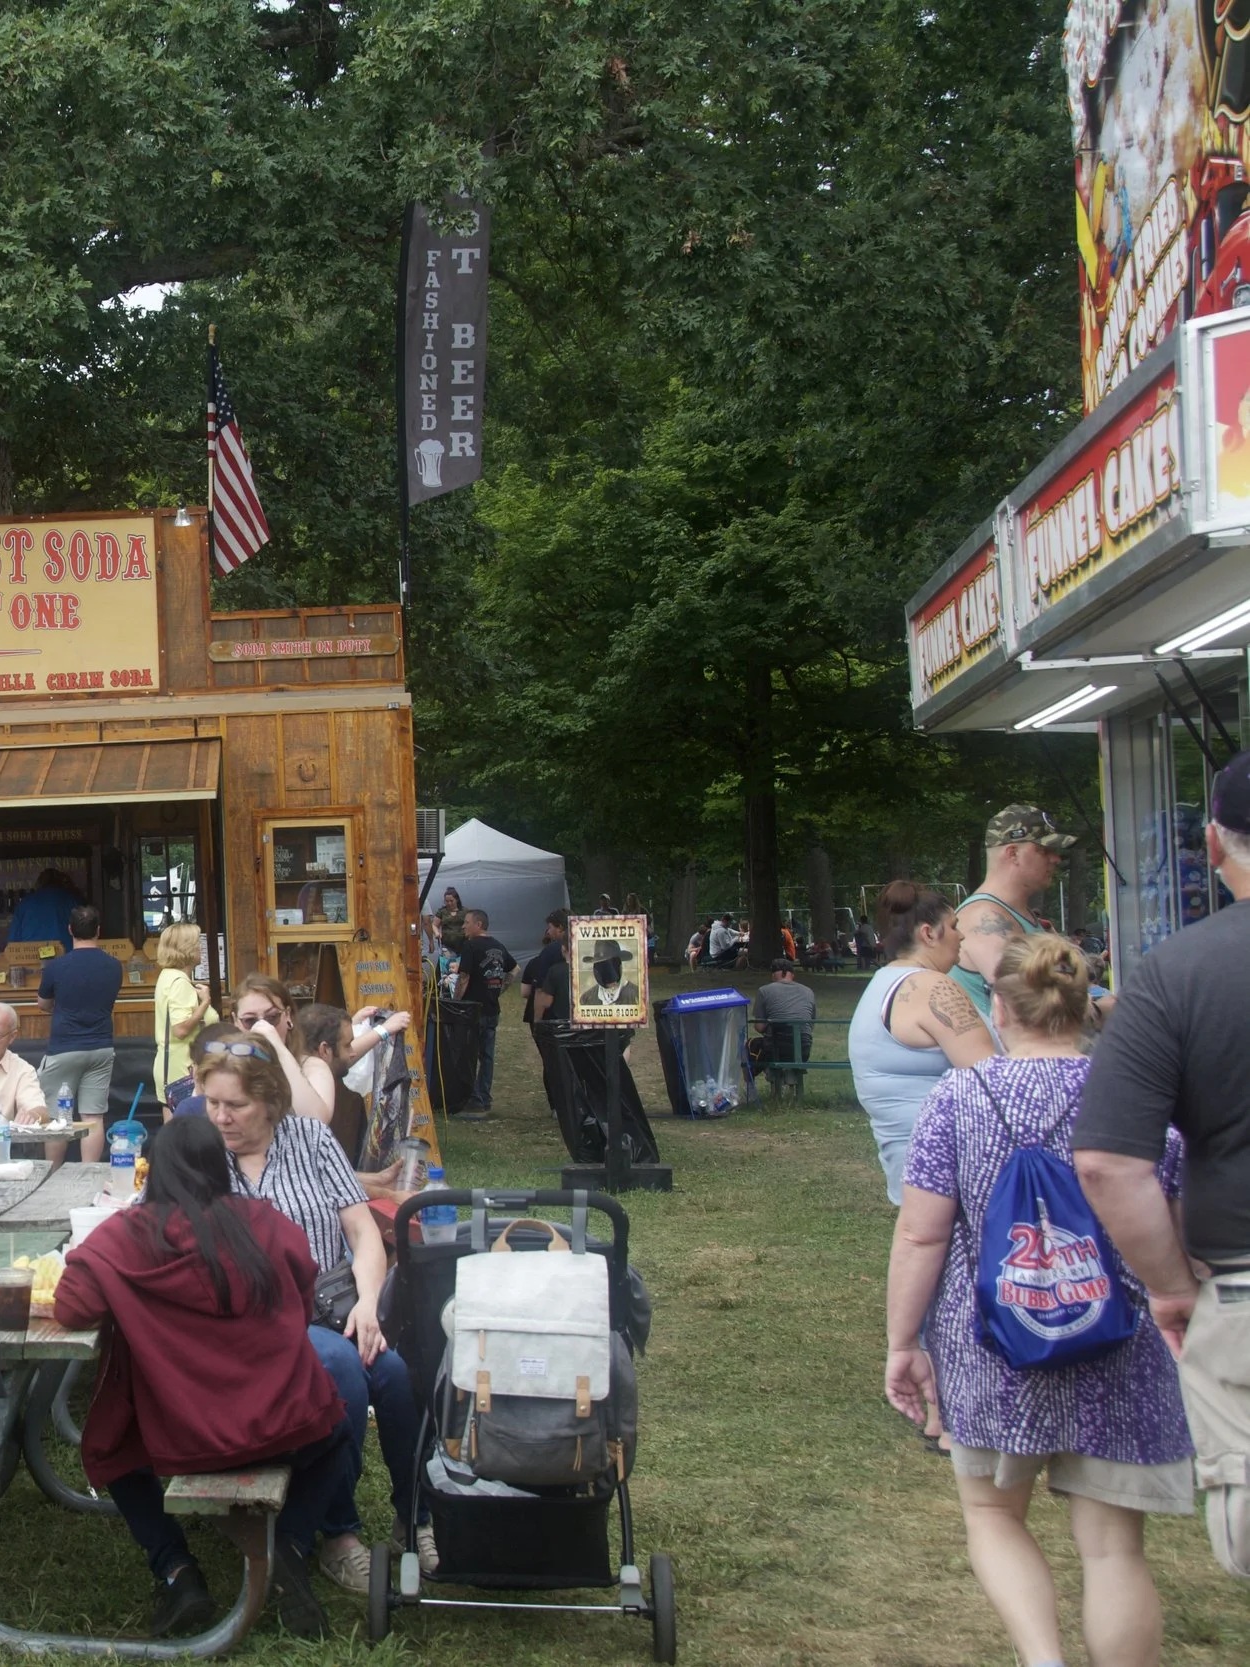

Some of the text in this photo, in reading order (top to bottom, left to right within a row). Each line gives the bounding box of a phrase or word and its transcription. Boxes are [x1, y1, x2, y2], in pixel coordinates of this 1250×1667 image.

[1132, 175, 1179, 292] FRIED
[1128, 222, 1189, 374] COOKIES
[419, 249, 442, 432] FASHIONED
[449, 323, 476, 458] BEER
[42, 529, 152, 583] SODA
[1025, 468, 1102, 600] FUNNEL
[8, 591, 82, 631] ONE
[234, 639, 371, 656] SODA SMITH ON DUTY
[916, 596, 961, 689] FUNNEL
[46, 671, 105, 691] CREAM
[110, 668, 154, 688] SODA
[7, 830, 32, 842] SODA
[37, 828, 84, 841] EXPRESS
[579, 925, 636, 938] WANTED
[581, 1008, 613, 1018] REWARD
[1000, 1276, 1109, 1310] BUBBA GUMP
